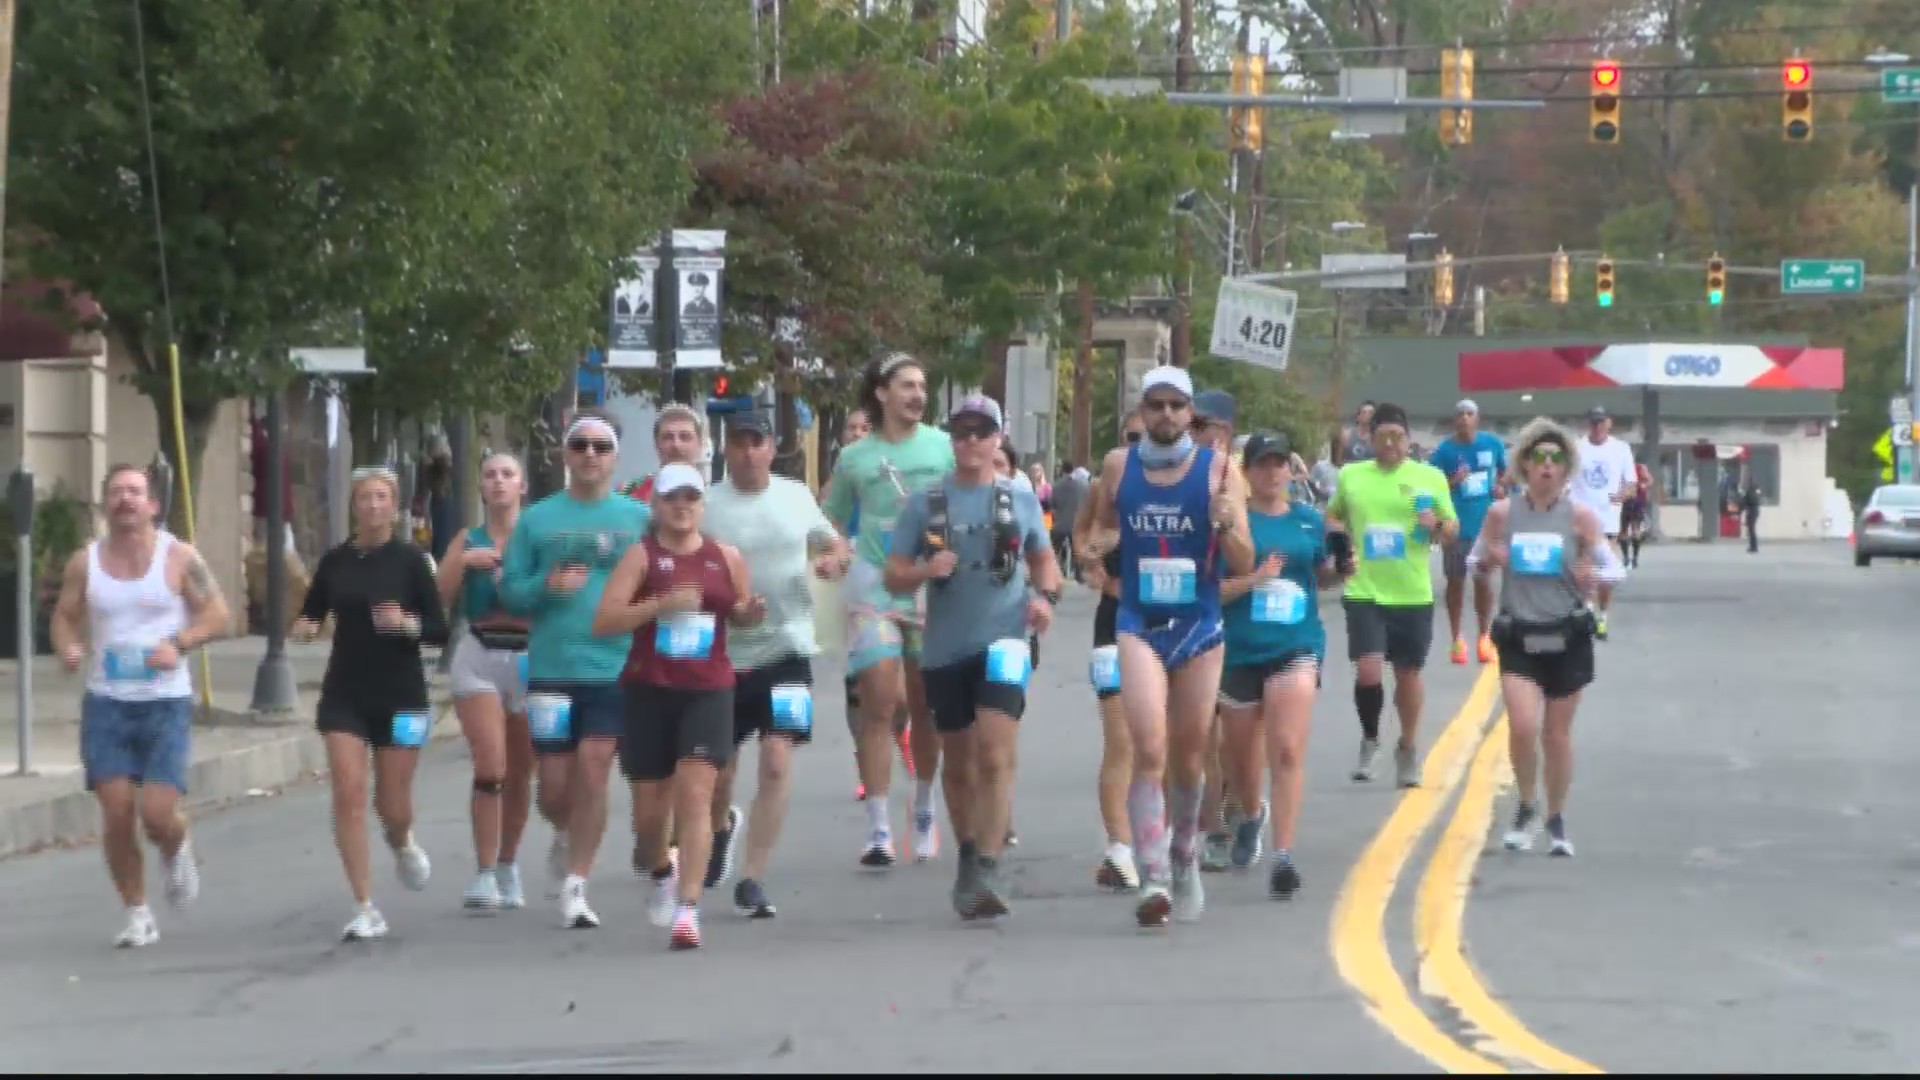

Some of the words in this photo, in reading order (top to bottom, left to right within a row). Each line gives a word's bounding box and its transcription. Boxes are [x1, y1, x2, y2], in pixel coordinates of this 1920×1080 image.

[1790, 277, 1833, 288] Lincoln
[1239, 314, 1288, 350] 4:20
[1127, 513, 1195, 532] ULTRA
